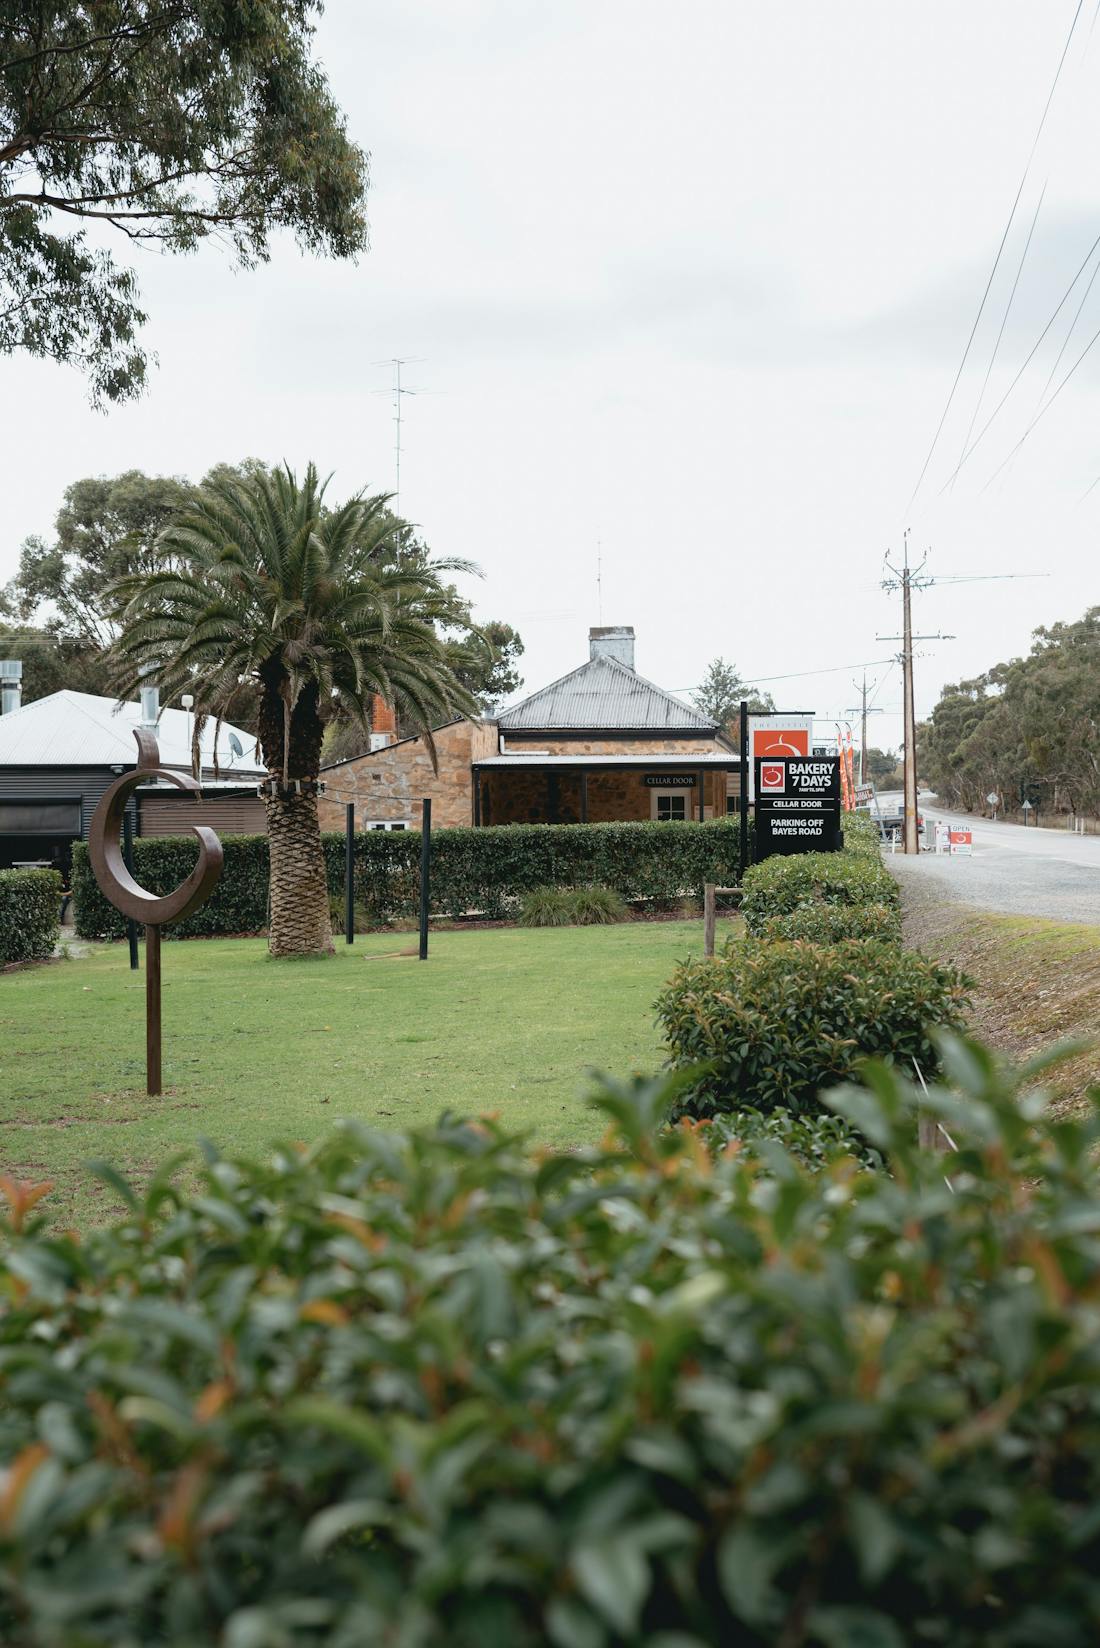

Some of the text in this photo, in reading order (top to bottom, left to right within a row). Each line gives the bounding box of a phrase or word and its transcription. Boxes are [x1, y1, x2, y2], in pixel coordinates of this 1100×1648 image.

[789, 764, 835, 774] BAKERY
[792, 776, 832, 786] 7 DAYS
